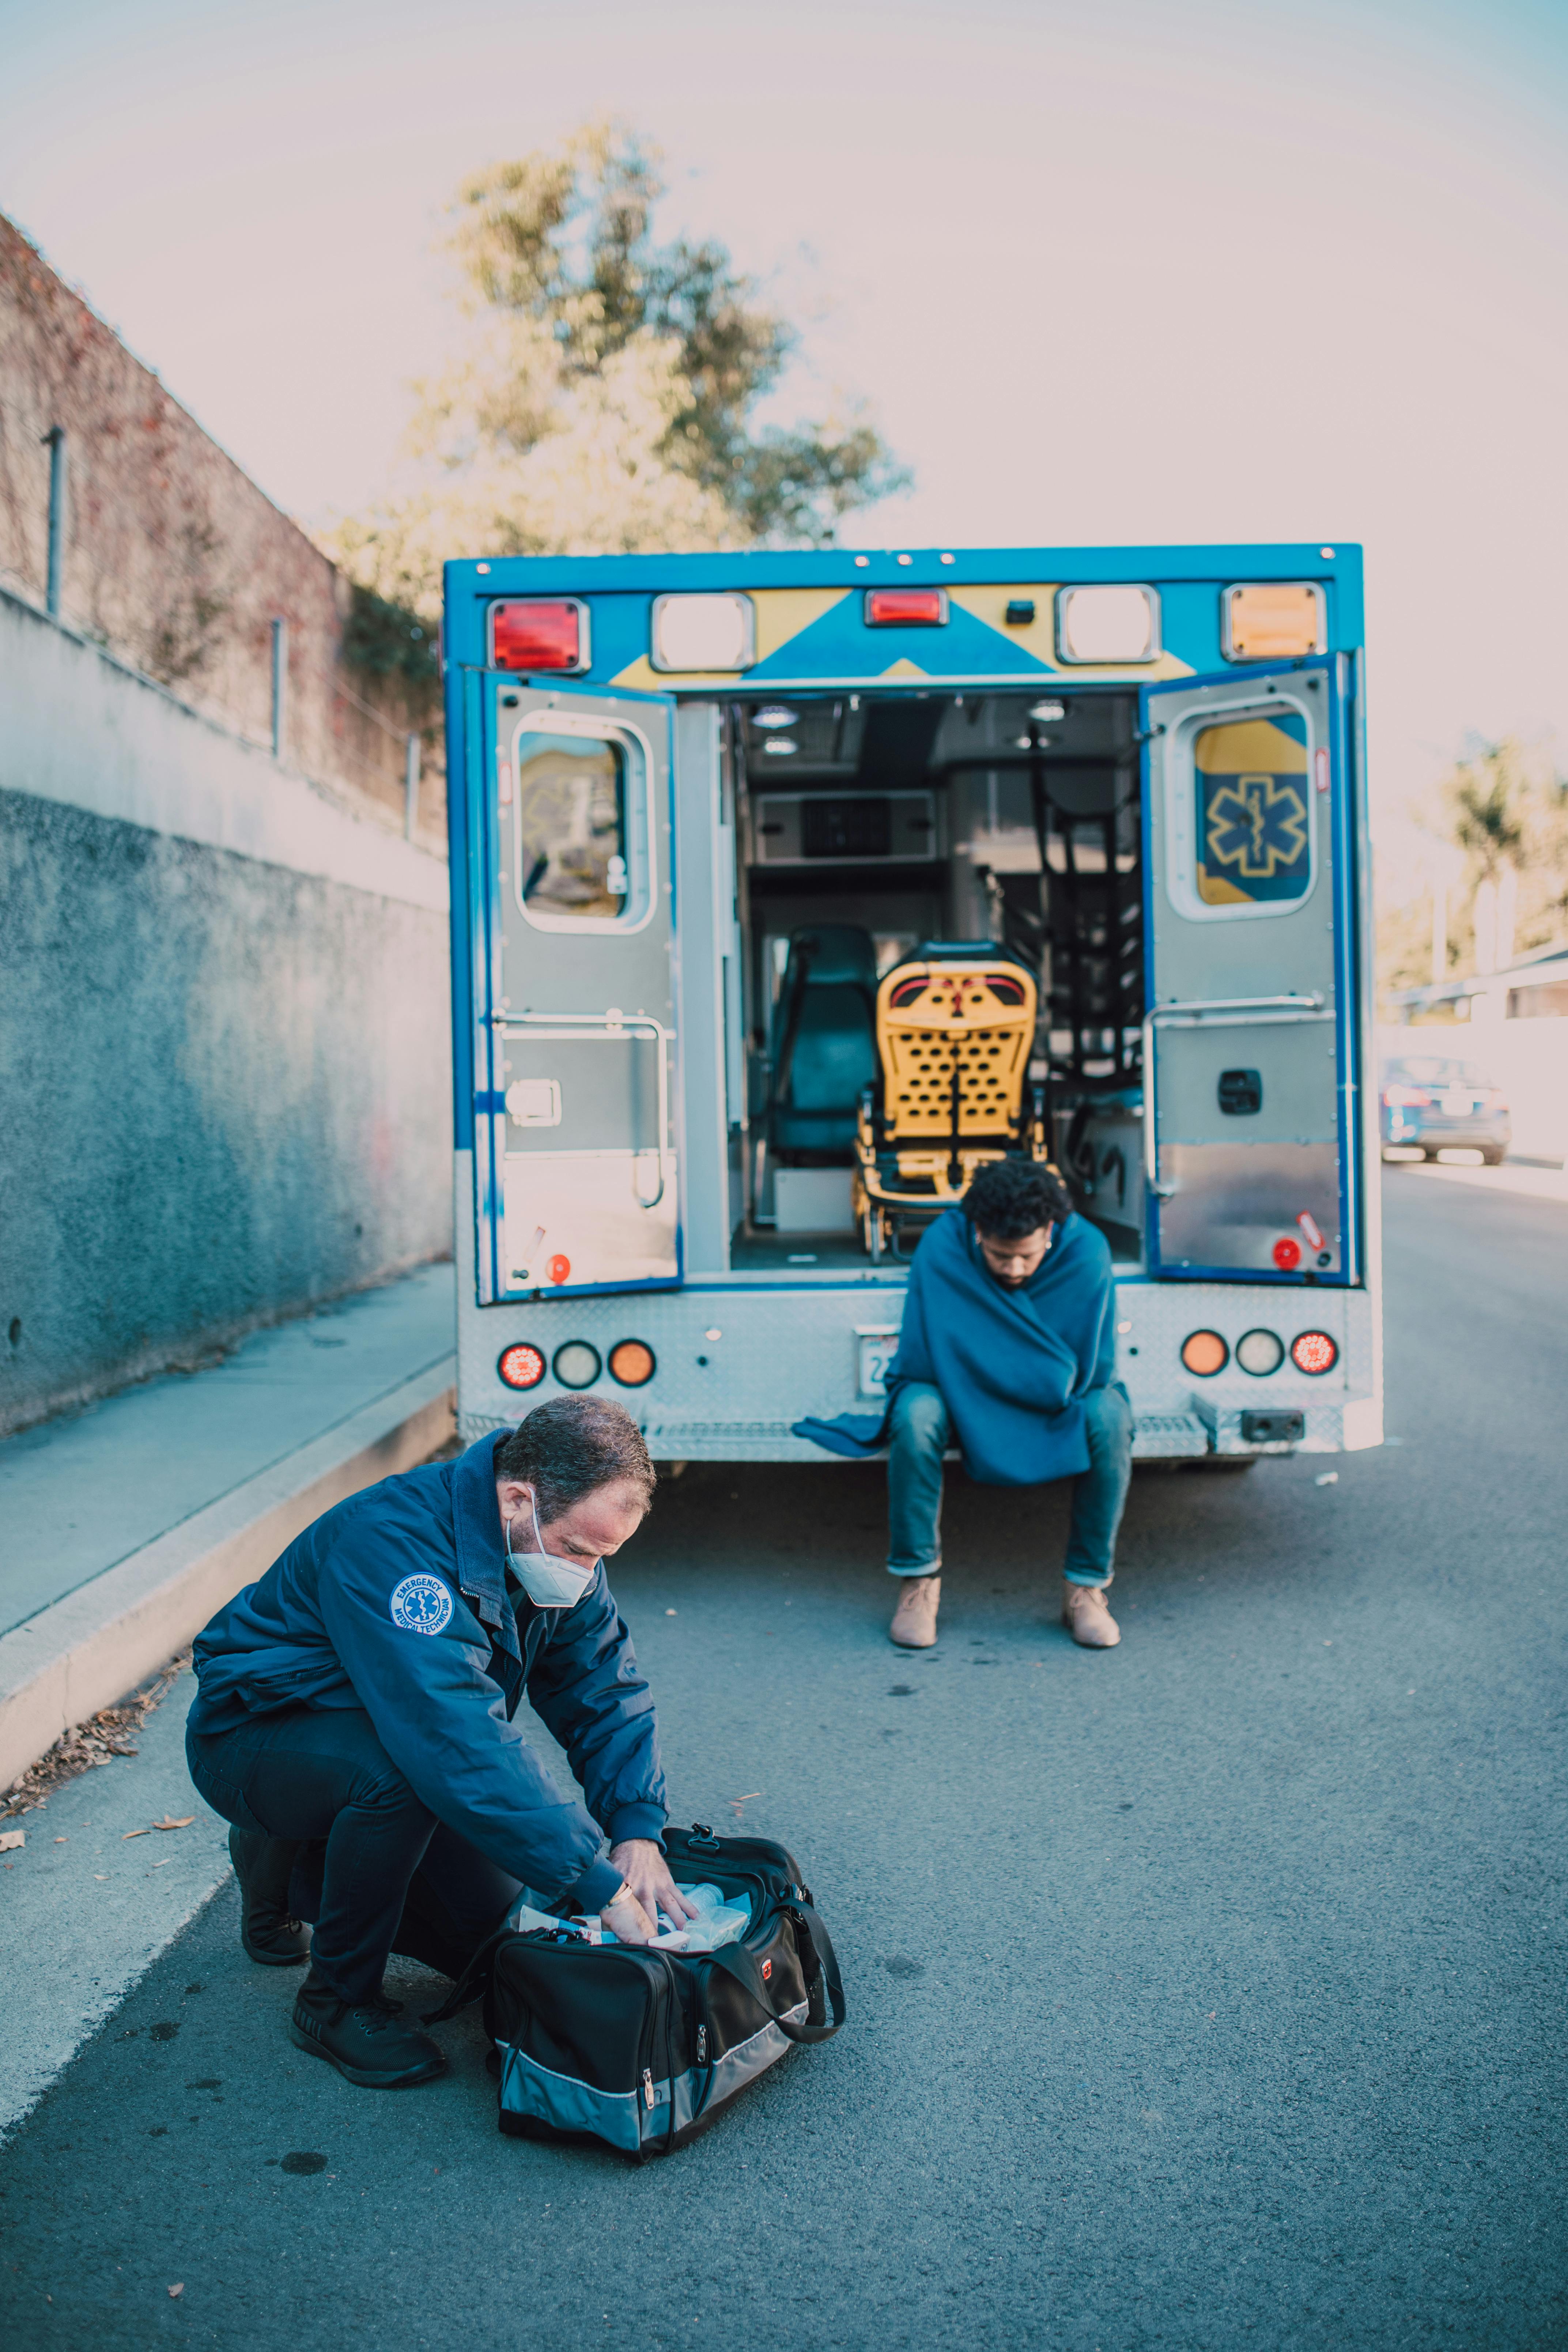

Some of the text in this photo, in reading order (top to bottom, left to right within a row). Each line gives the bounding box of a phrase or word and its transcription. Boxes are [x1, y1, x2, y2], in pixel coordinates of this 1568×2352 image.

[397, 1578, 442, 1599] EMERGENCY
[394, 1598, 449, 1633] MEDICAL TECHNICIAN
